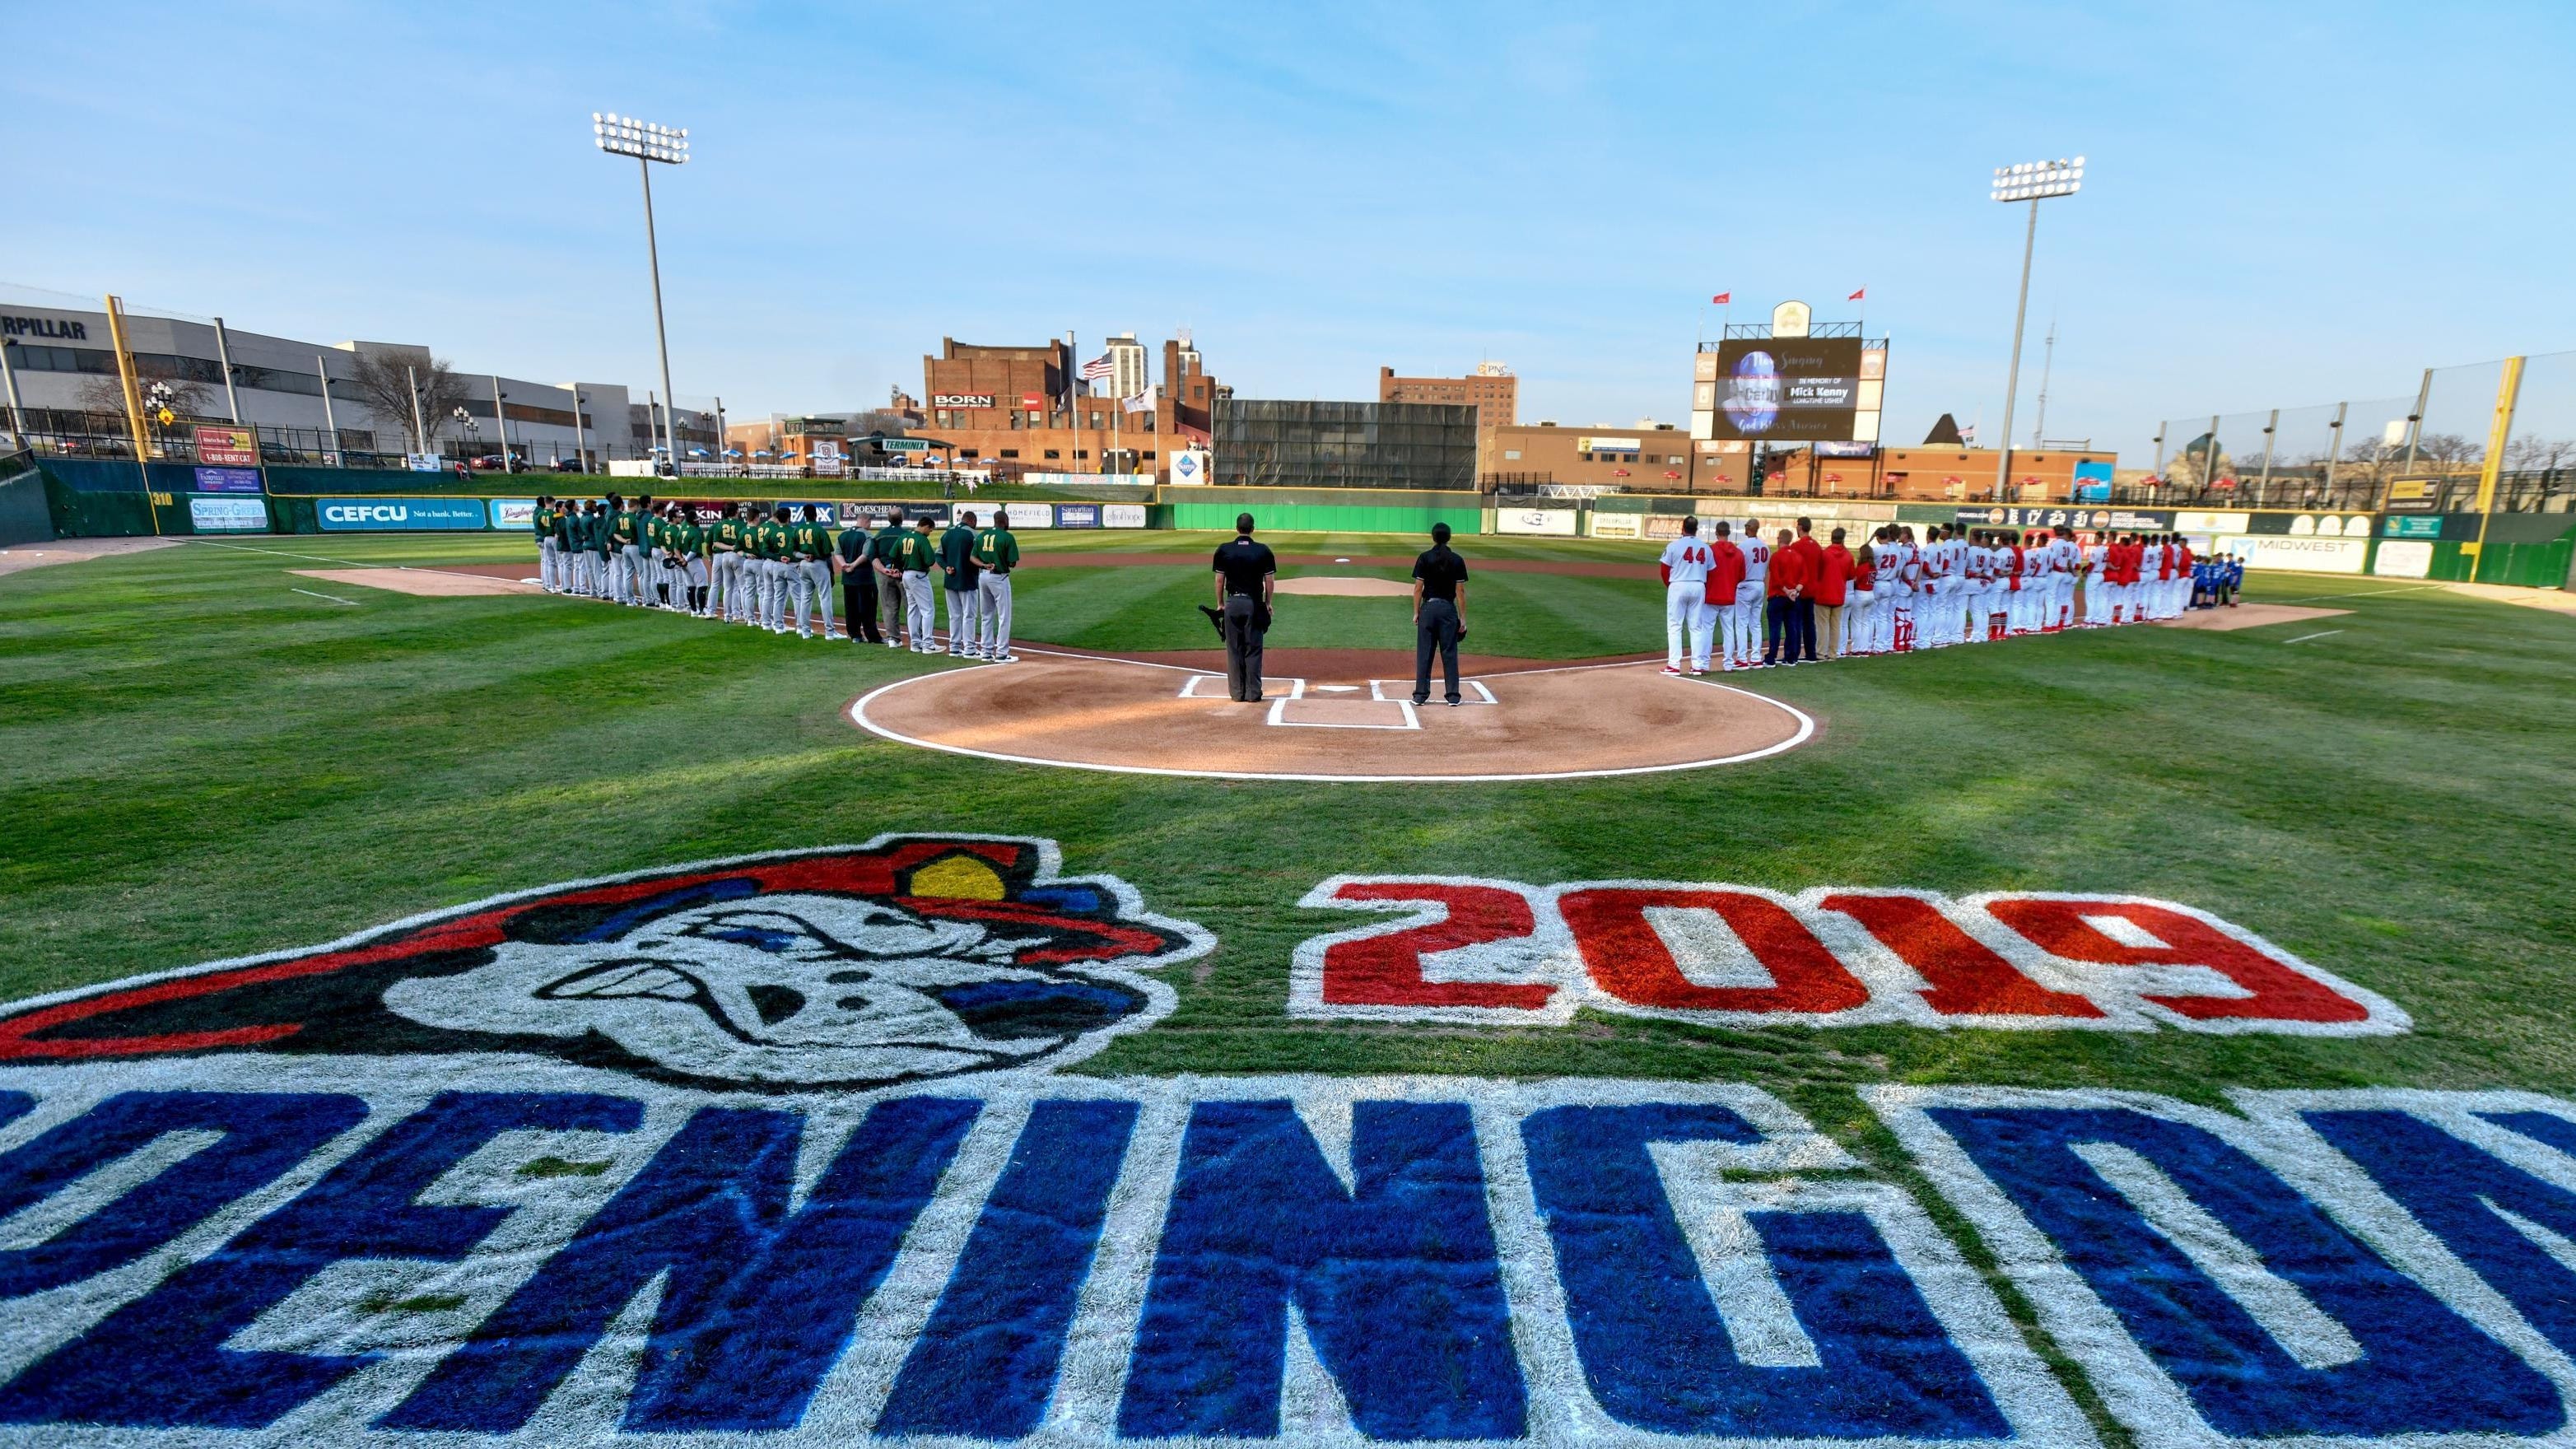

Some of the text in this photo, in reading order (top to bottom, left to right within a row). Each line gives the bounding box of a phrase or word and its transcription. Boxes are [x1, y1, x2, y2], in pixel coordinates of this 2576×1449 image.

[1488, 366, 1507, 374] PNC
[935, 395, 991, 403] BORN
[1791, 387, 1814, 397] Mick
[1816, 387, 1848, 398] Kenny
[885, 440, 925, 450] TERMINIX
[240, 454, 250, 463] CAT
[153, 492, 173, 506] 310
[325, 506, 408, 522] CEFCU
[664, 531, 671, 545] 5
[681, 530, 687, 544] 7
[722, 524, 736, 539] 21
[798, 528, 813, 545] 14
[776, 532, 786, 547] 3
[901, 538, 915, 555] 10
[982, 534, 996, 552] 11
[2257, 540, 2350, 553] MIDWEST
[1683, 546, 1706, 564] 44
[1753, 546, 1768, 564] 30
[1880, 553, 1897, 568] 28
[1313, 878, 2387, 1027] 2019
